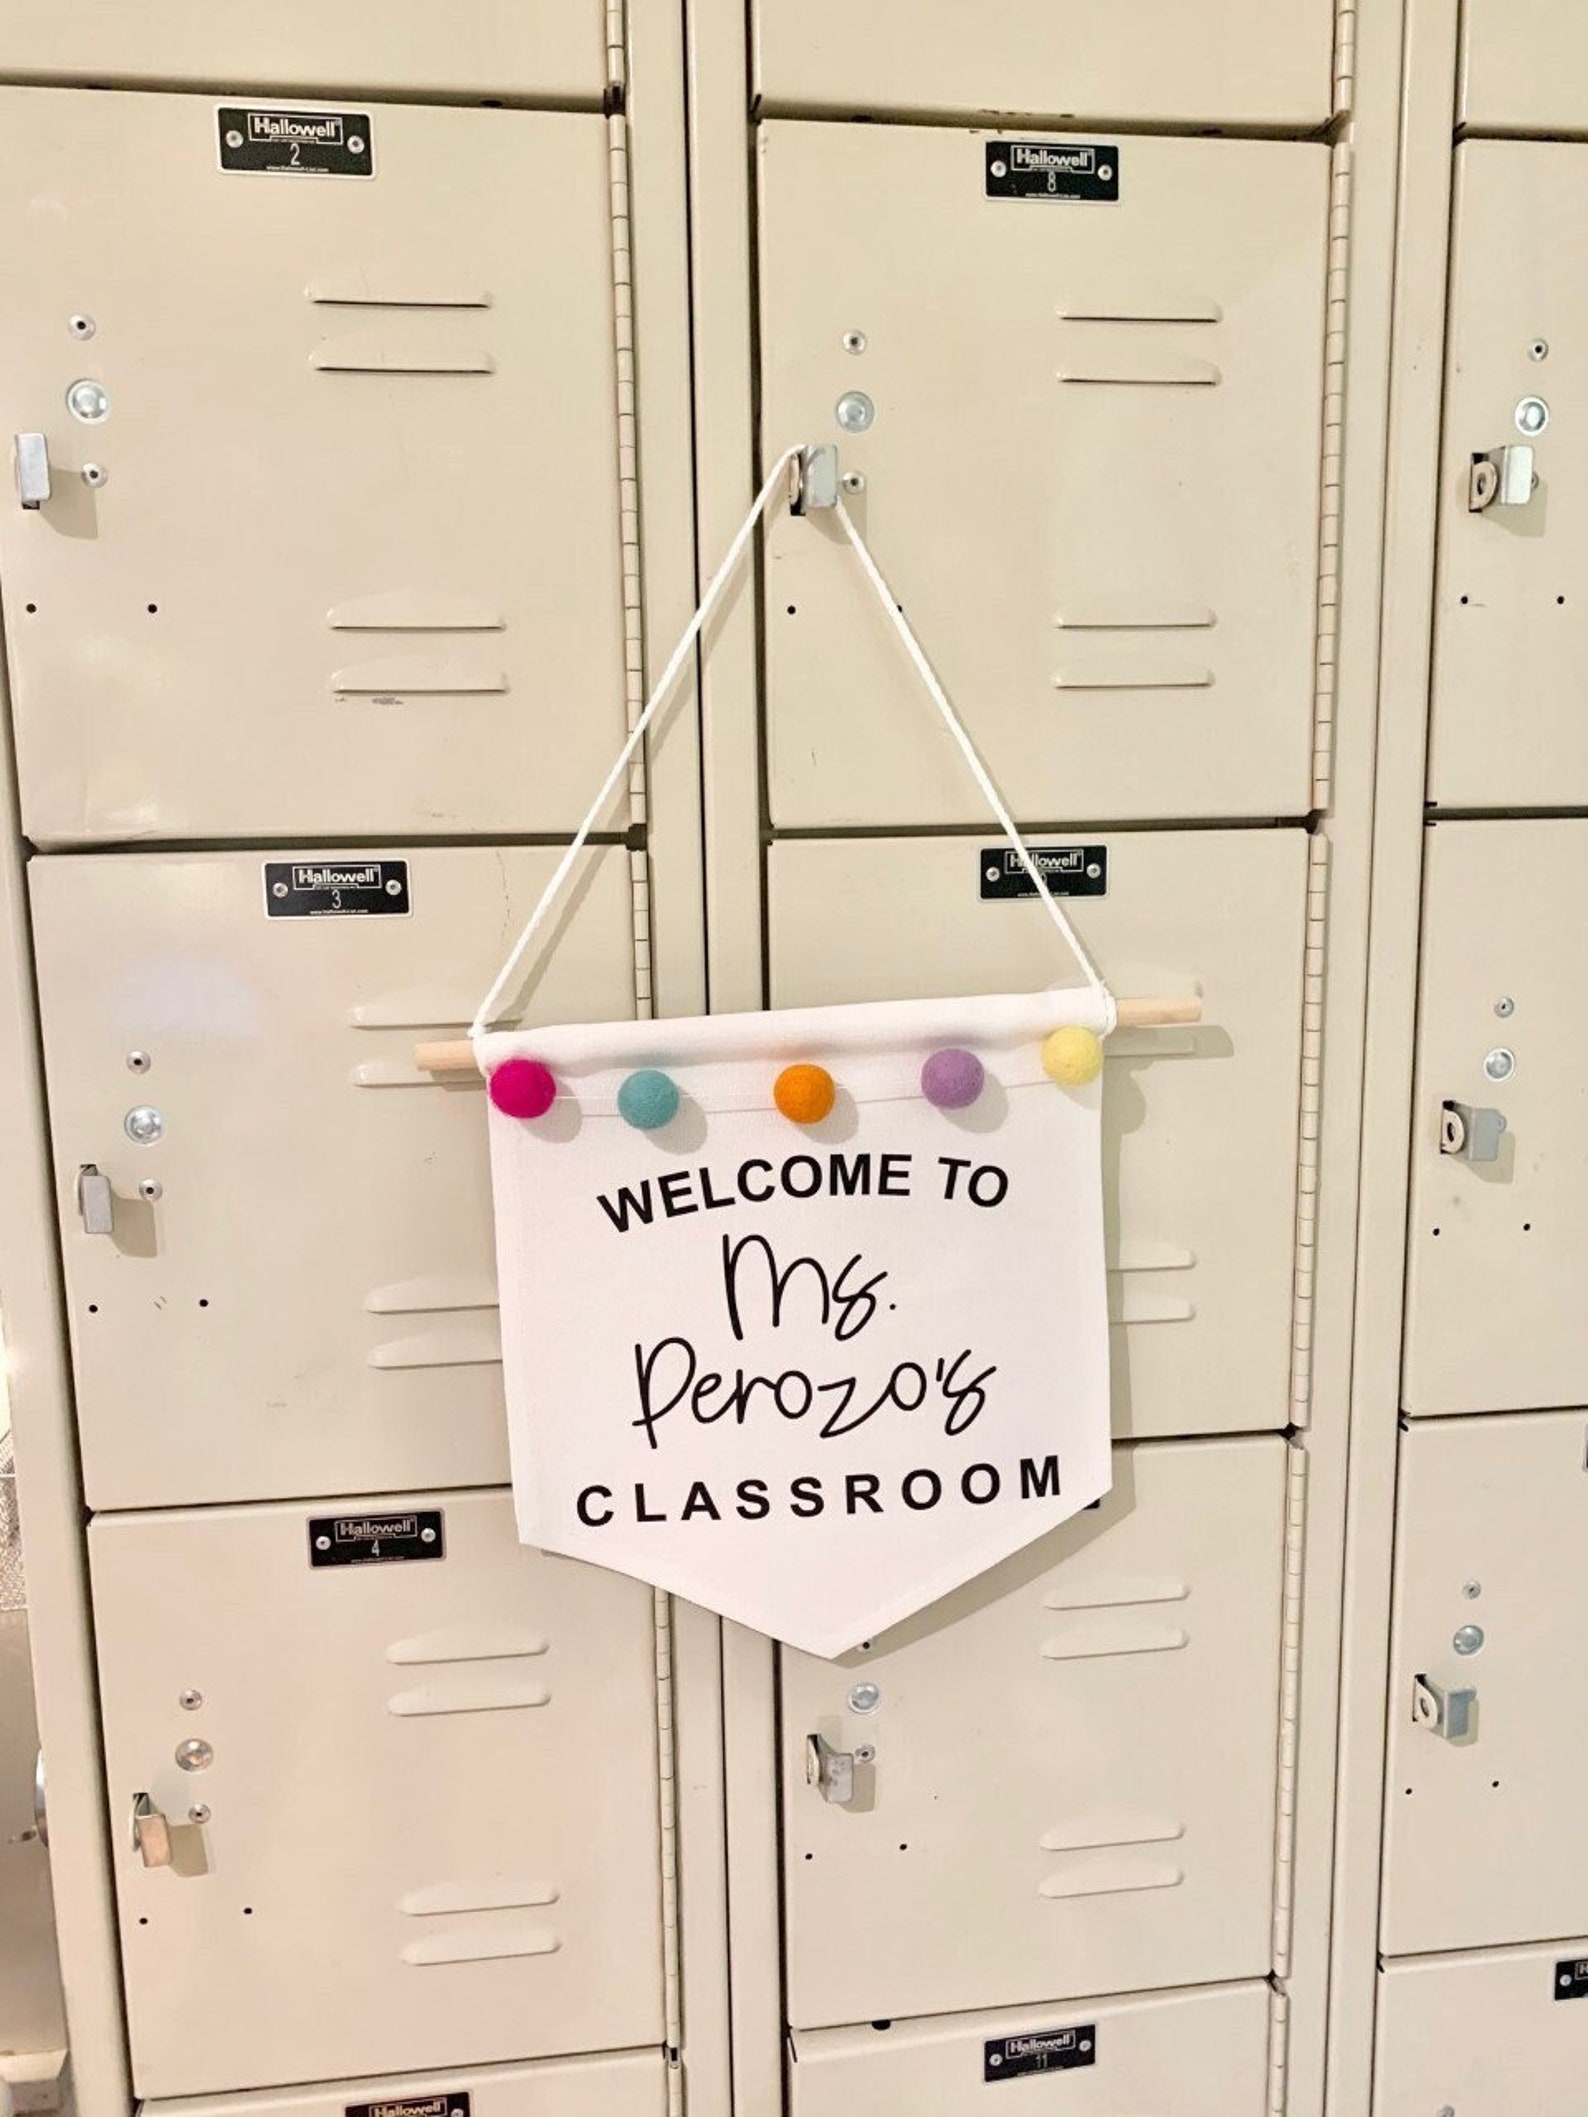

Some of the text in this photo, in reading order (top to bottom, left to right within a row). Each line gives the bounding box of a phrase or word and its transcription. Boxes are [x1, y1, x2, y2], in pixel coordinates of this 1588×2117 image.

[253, 117, 336, 137] Hallowell
[290, 143, 300, 165] 2
[1016, 148, 1088, 167] Hallowell
[1047, 171, 1056, 192] 8
[1010, 853, 1078, 867] Hllowell
[298, 868, 375, 884] Hallowell
[332, 890, 341, 909] 3
[597, 1153, 1008, 1232] WELCOME TO
[723, 1234, 896, 1340] Ms.
[632, 1337, 996, 1449] Perozo's
[576, 1455, 1061, 1526] CLASSROOM
[340, 1519, 411, 1535] Hallowell
[371, 1540, 380, 1556] 4
[1010, 2034, 1070, 2053] Hallowell
[1035, 2053, 1048, 2068] 11
